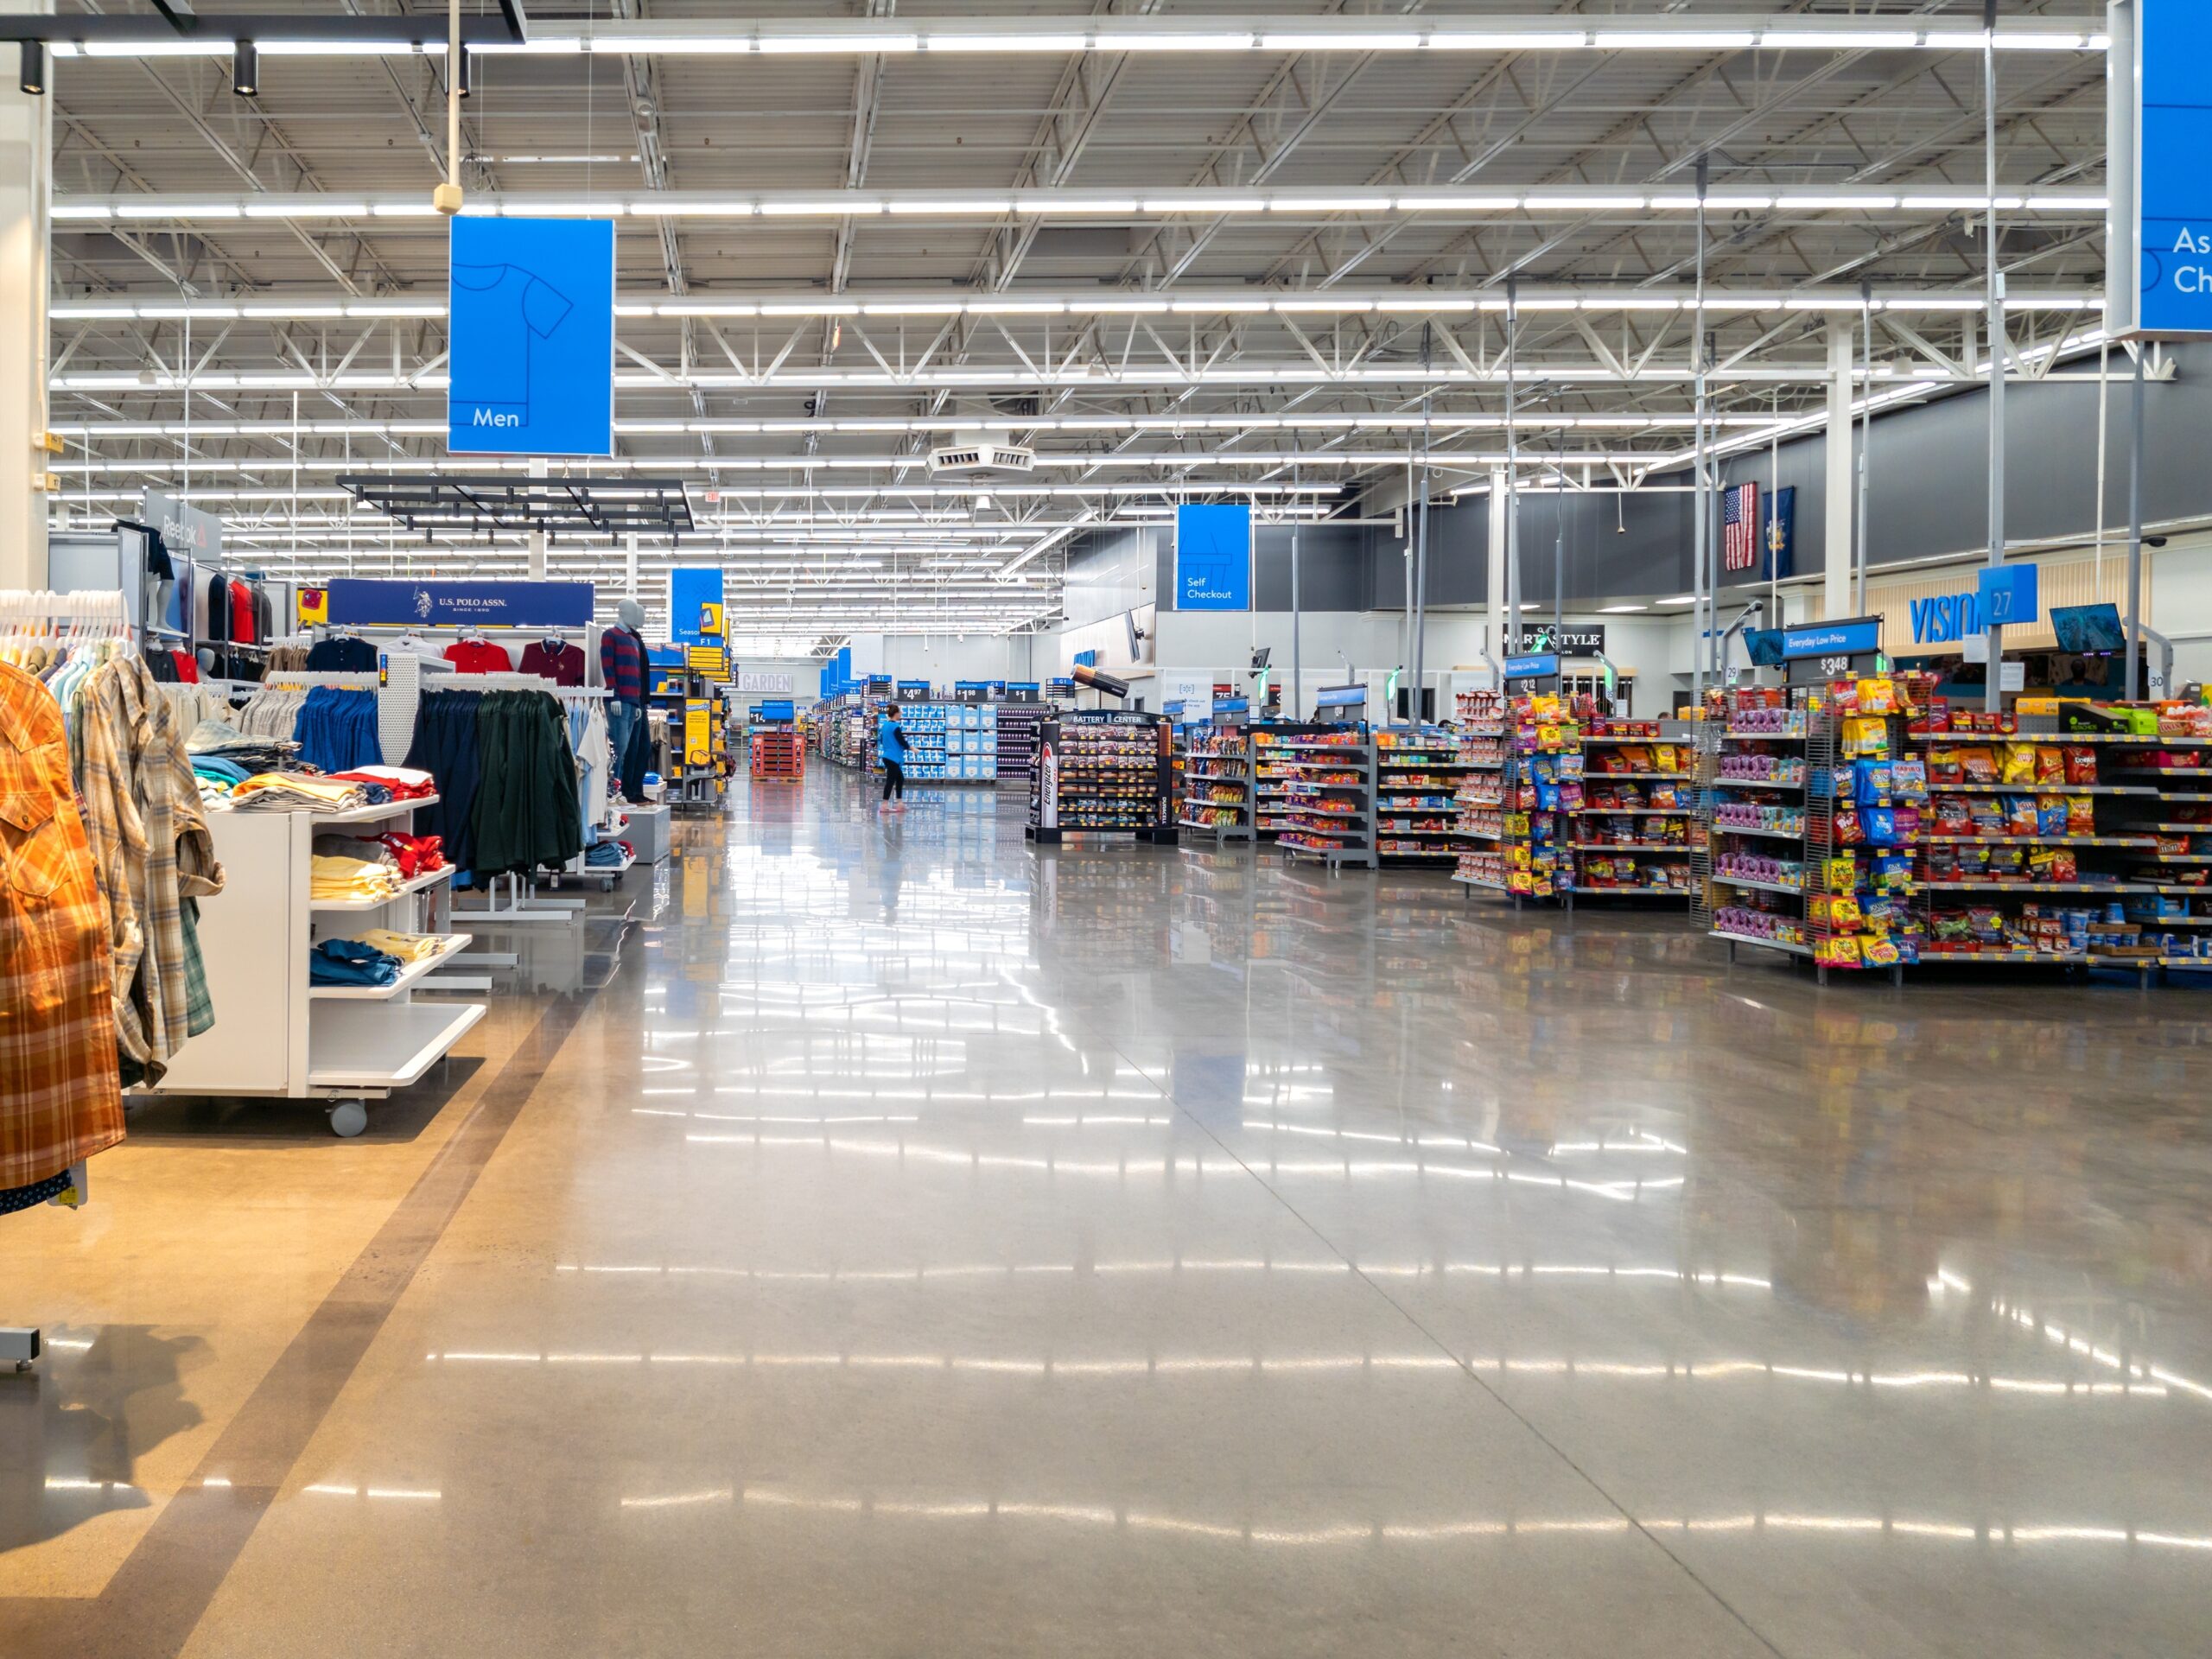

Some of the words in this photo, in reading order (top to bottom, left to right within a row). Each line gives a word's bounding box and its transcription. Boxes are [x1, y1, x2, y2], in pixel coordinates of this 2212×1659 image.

[473, 408, 518, 427] Men
[1187, 577, 1206, 587] Self
[1187, 589, 1232, 599] Checkout
[456, 598, 480, 607] POLO
[1993, 591, 2012, 616] 27
[1788, 637, 1815, 648] Everyday
[1816, 636, 1829, 645] Low
[1829, 633, 1847, 644] Price
[1728, 667, 1737, 677] 29
[743, 674, 791, 690] GARDEN
[2151, 677, 2164, 687] 30
[1043, 763, 1053, 805] Energizer
